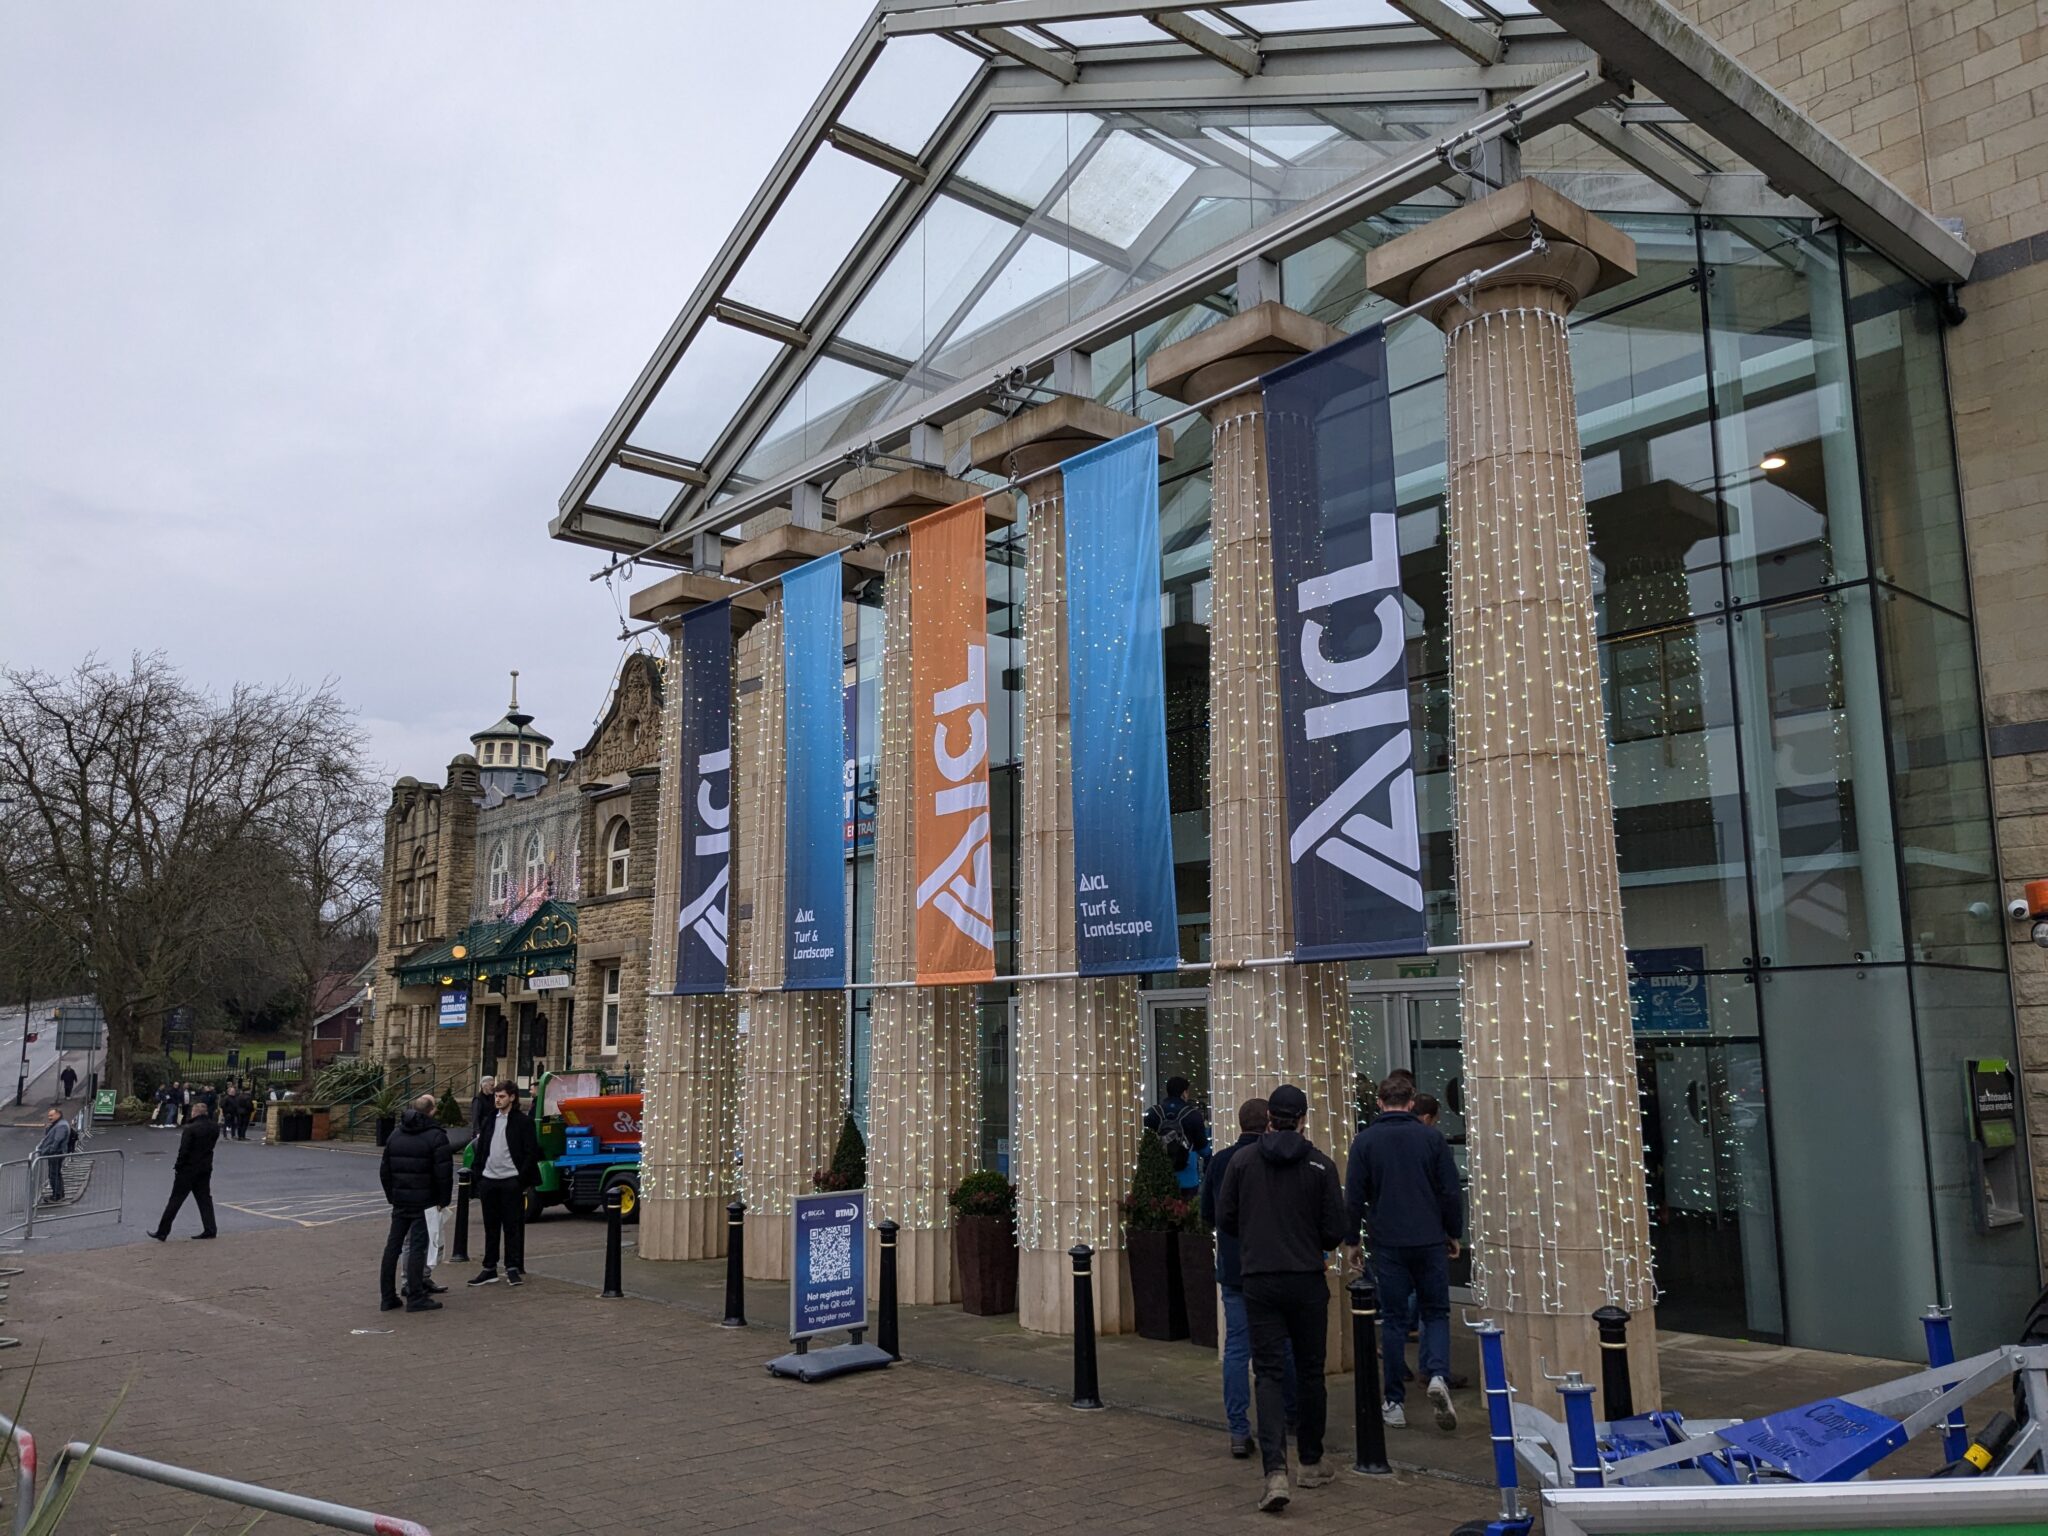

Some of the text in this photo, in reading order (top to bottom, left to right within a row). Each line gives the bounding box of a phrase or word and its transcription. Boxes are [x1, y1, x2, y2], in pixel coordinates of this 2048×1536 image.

[1080, 899, 1121, 917] Turf &
[794, 930, 818, 943] Turf &
[1083, 920, 1153, 938] Landscape
[793, 947, 834, 960] Landscape
[807, 1286, 853, 1301] Not registered?
[804, 1297, 856, 1313] Scan the QR code
[808, 1316, 815, 1324] to
[816, 1313, 837, 1324] register
